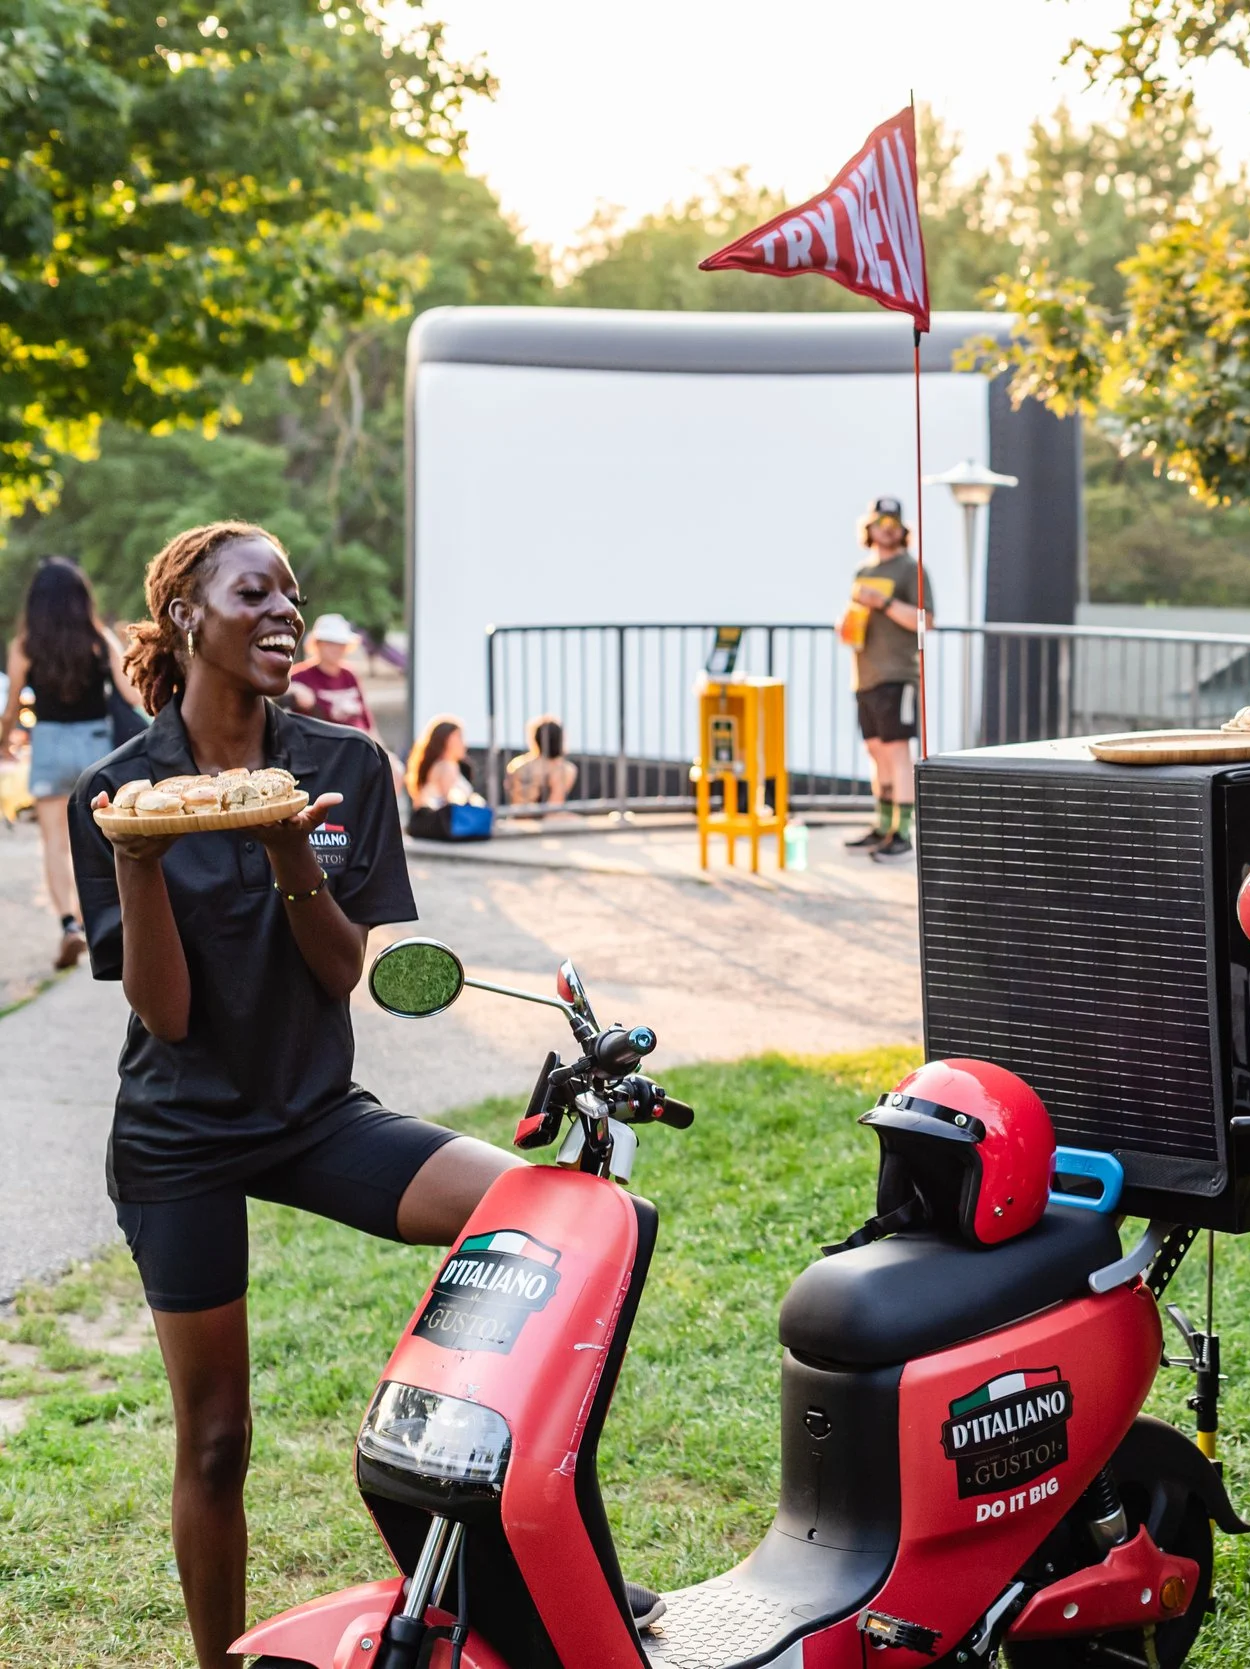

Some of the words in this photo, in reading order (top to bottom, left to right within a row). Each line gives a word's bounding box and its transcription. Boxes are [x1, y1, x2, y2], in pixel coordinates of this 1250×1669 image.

[752, 199, 838, 272] TRY
[833, 127, 925, 312] NEW
[308, 833, 347, 846] ALIANO
[439, 1259, 548, 1300] D'ITALIANO
[951, 1390, 1066, 1449] D'ITALIANO
[974, 1440, 1057, 1486] GUSTO!
[976, 1499, 1006, 1523] DO
[1009, 1491, 1027, 1513] IT
[1029, 1477, 1059, 1506] BIG
